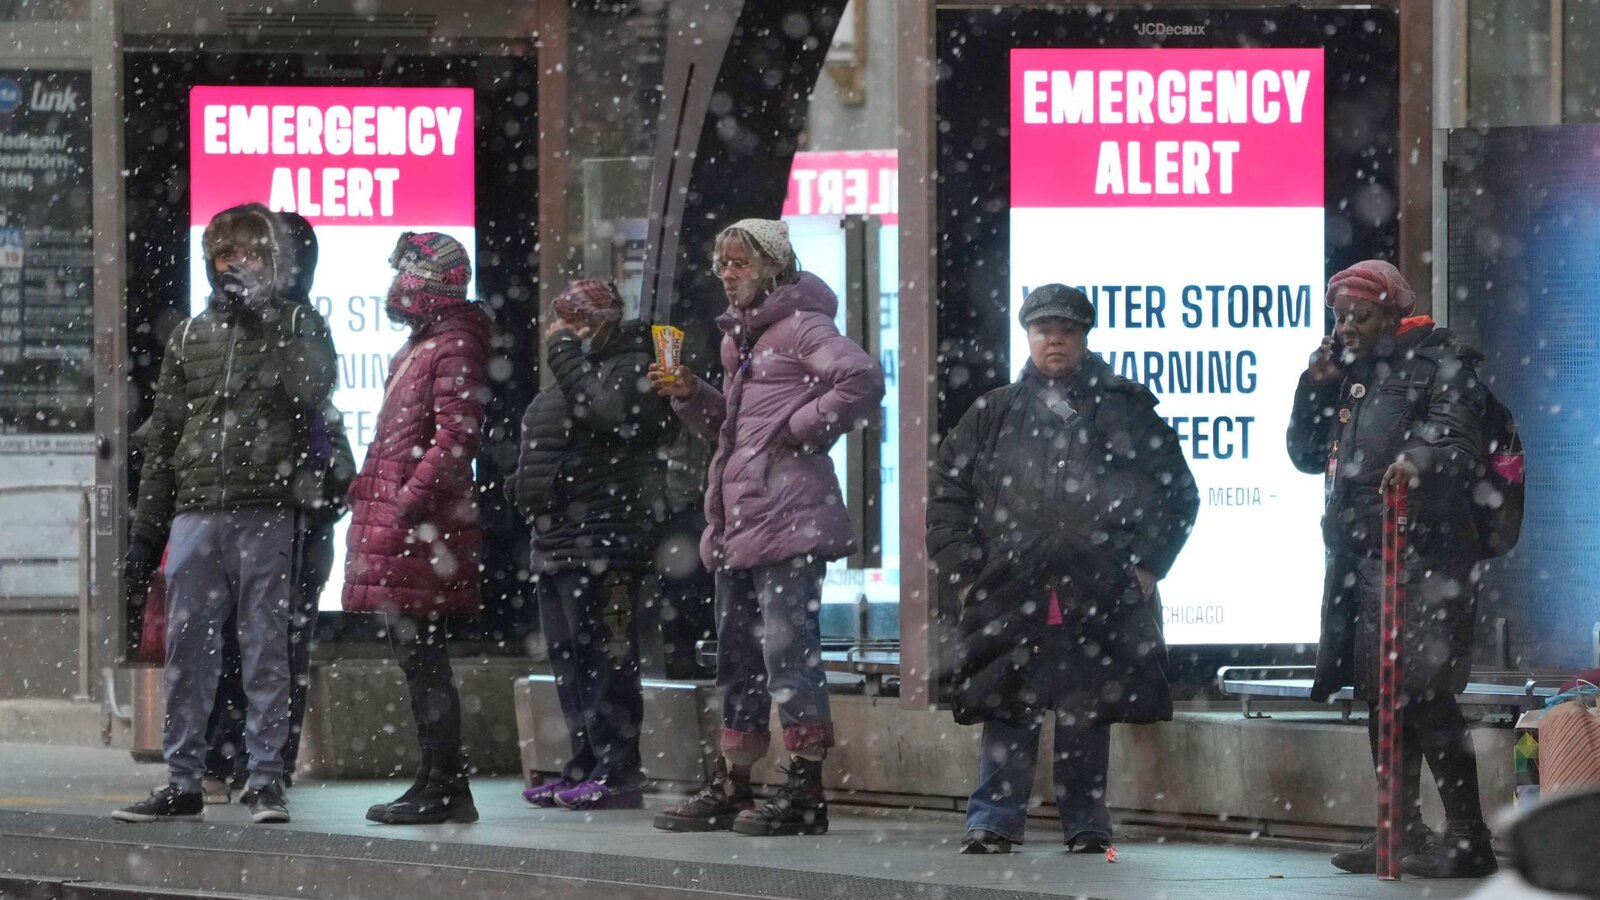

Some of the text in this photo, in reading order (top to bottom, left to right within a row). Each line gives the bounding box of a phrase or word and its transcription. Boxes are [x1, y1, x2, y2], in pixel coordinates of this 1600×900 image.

[1137, 22, 1206, 36] JCDecaux
[30, 80, 78, 112] Link
[1023, 69, 1311, 124] EMERGENCY
[204, 104, 463, 156] EMERGENCY
[0, 170, 34, 188] tate
[1094, 140, 1240, 194] ALERT
[269, 167, 401, 217] ALERT
[1022, 284, 1311, 328] TER STORM
[1161, 416, 1255, 459] FECT
[1208, 487, 1262, 506] MEDIA
[1162, 605, 1224, 624] CHICAGO
